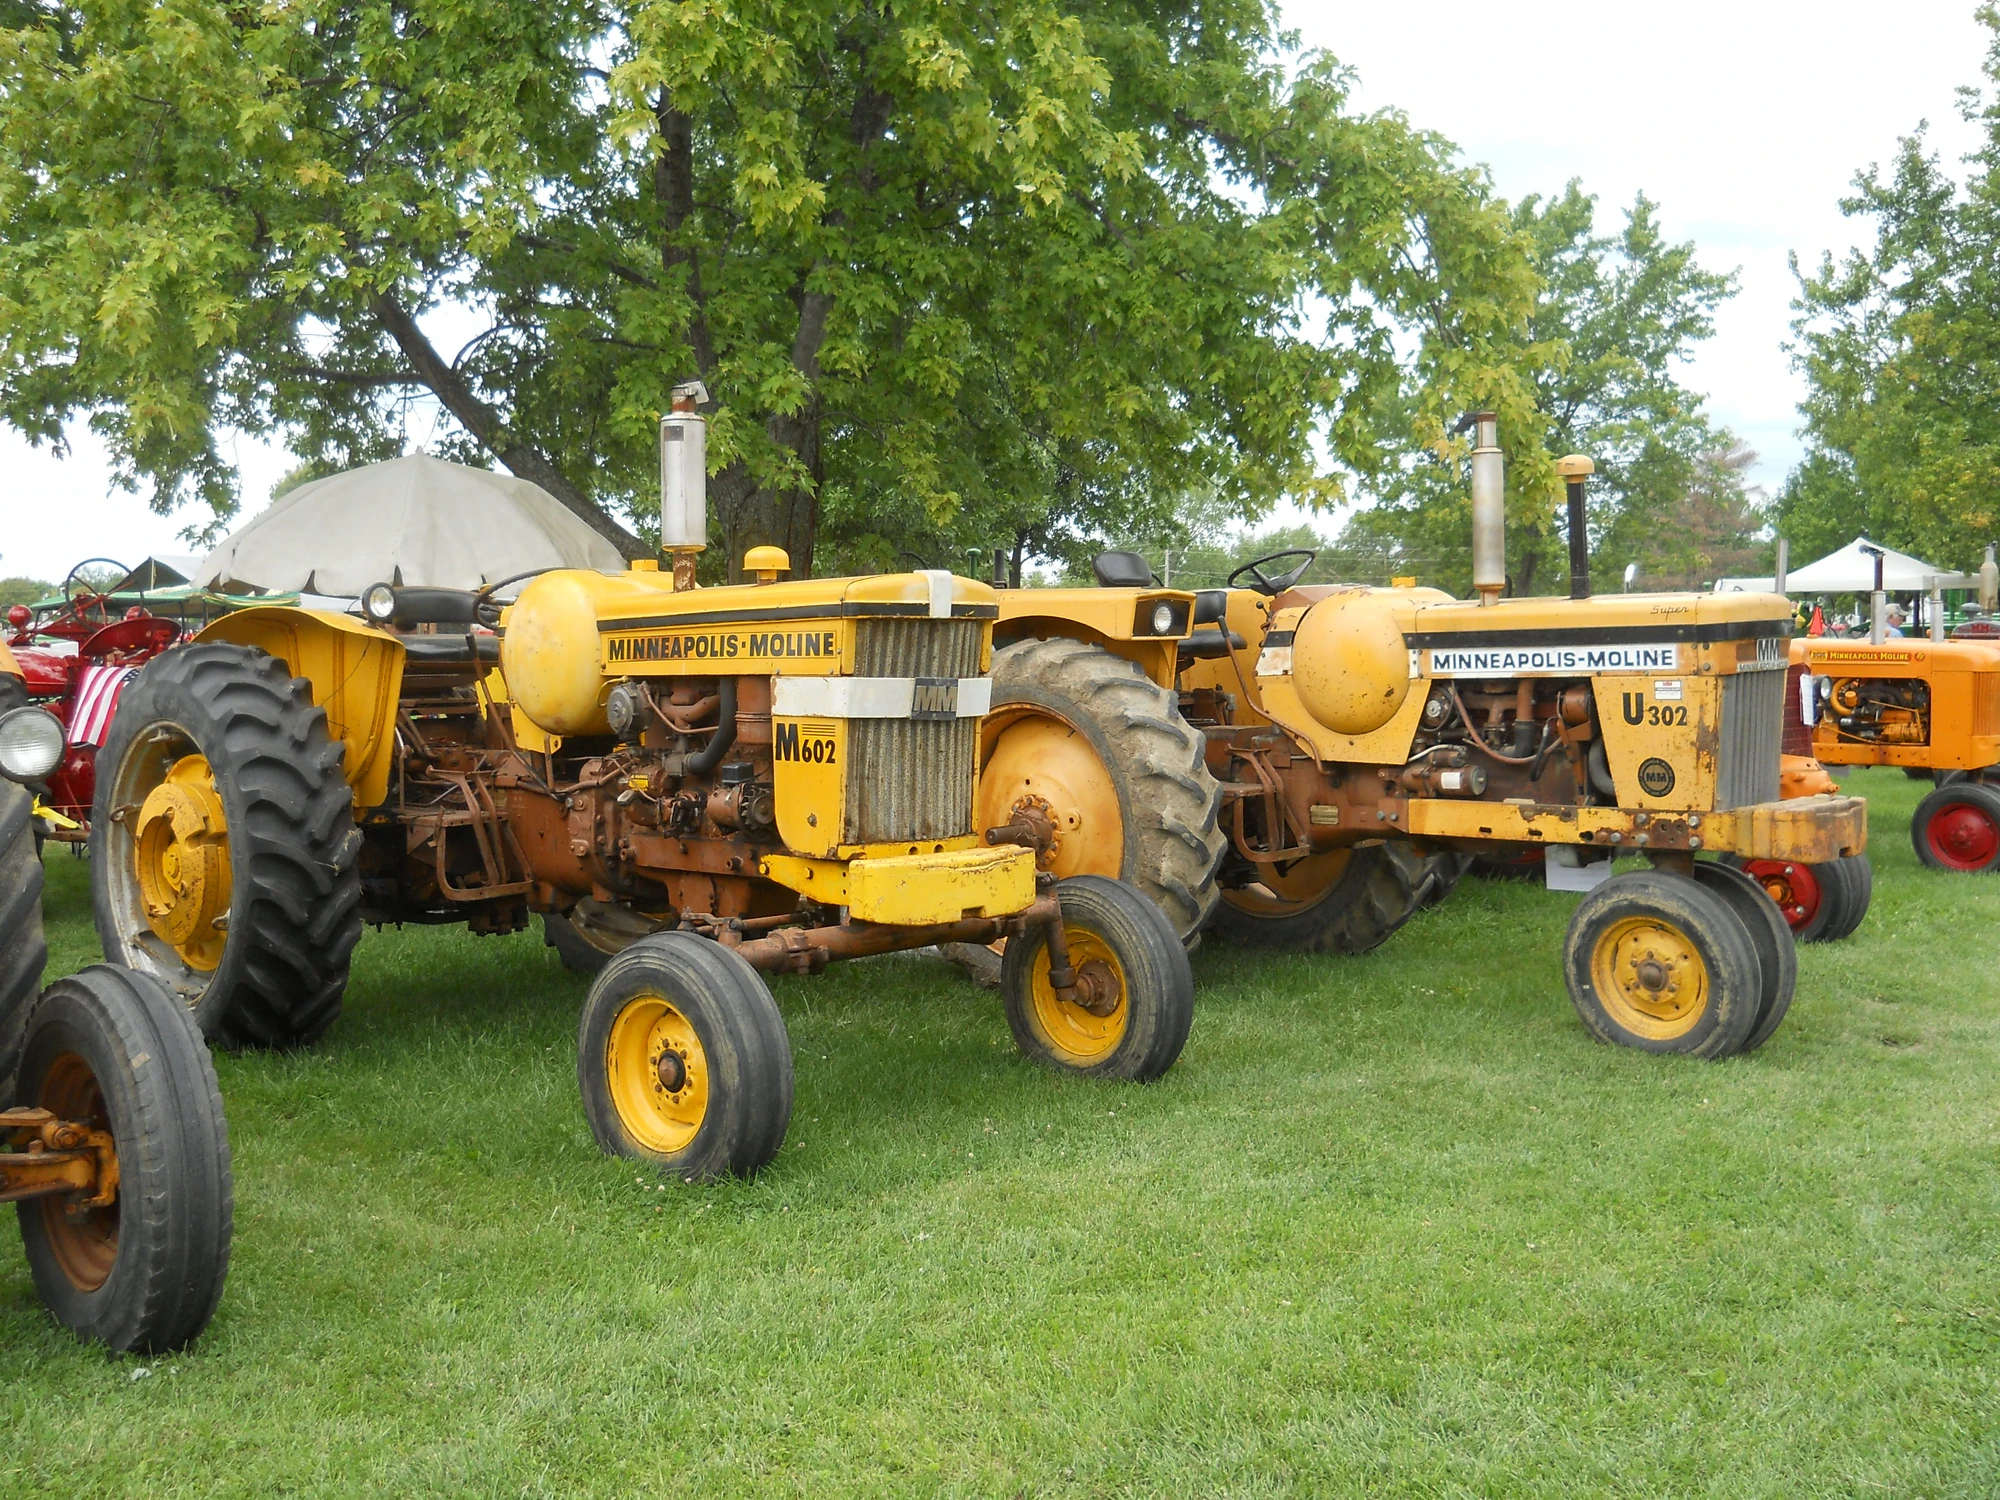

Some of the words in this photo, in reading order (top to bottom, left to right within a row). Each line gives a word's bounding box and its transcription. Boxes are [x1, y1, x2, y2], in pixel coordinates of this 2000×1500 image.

[1650, 604, 1689, 622] Super
[1434, 649, 1673, 670] MINNEAPOLIS-MOLINE
[1757, 638, 1780, 661] MM
[914, 684, 957, 712] MM
[1646, 772, 1667, 783] MM
